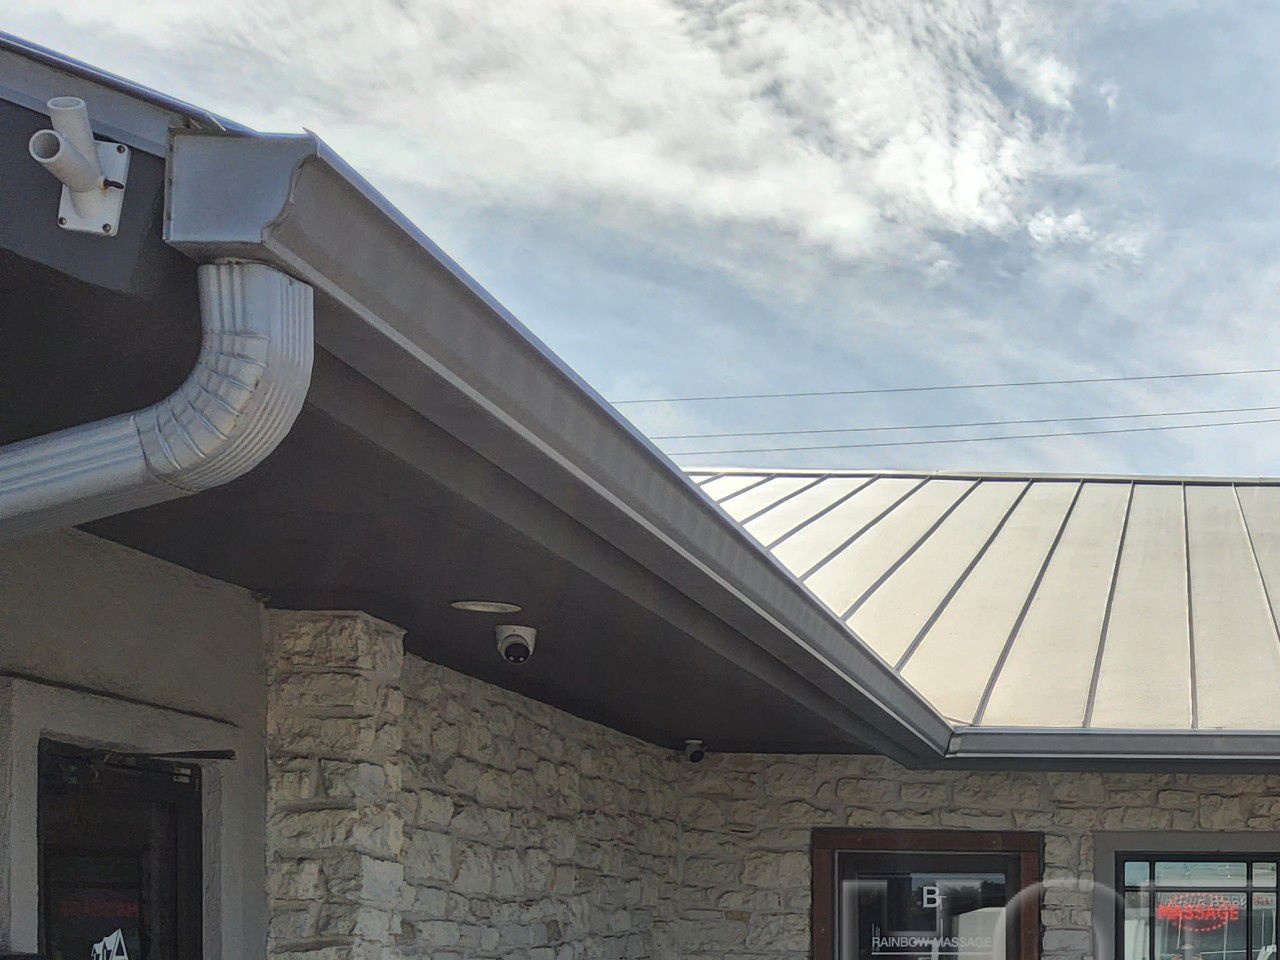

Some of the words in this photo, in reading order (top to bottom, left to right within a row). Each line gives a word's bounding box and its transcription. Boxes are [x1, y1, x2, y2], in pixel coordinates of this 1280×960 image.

[922, 886, 941, 907] B
[871, 937, 930, 948] RAINBOW
[932, 936, 993, 948] MASSAGE
